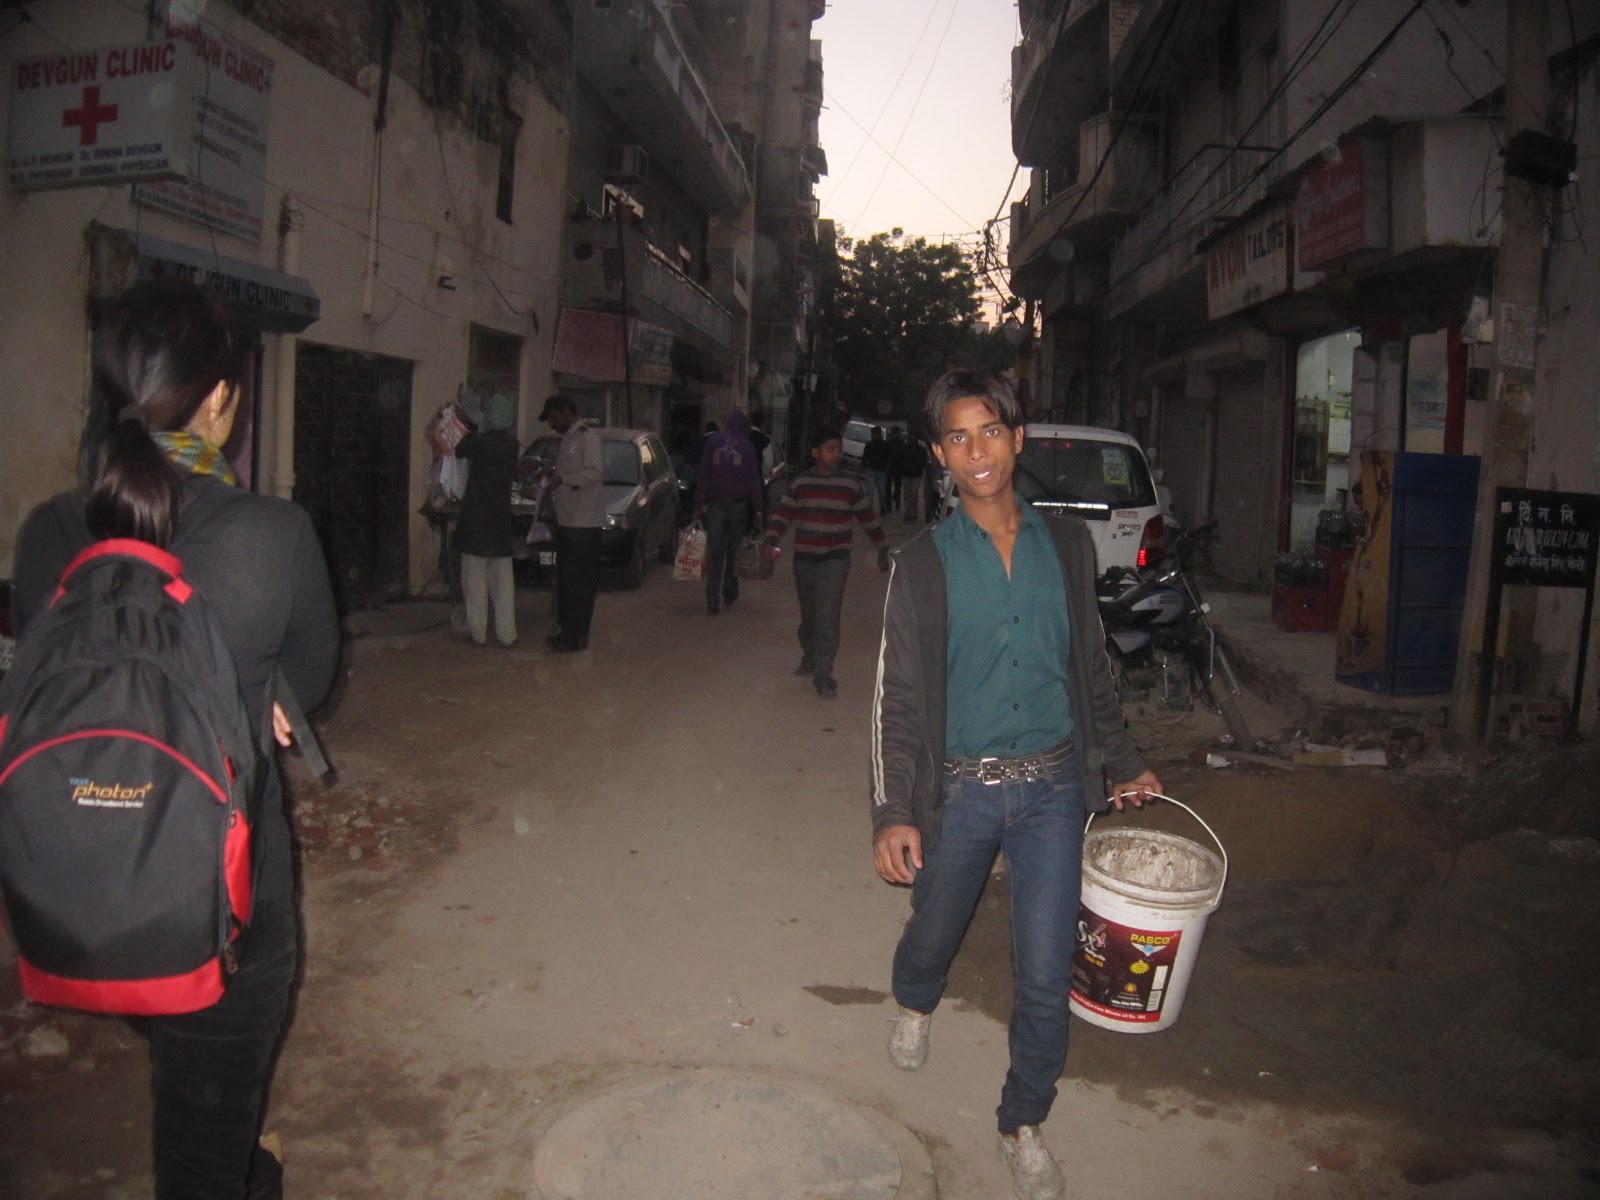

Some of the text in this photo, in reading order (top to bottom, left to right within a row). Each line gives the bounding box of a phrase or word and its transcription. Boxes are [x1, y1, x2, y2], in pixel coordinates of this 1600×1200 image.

[18, 54, 98, 90] DEVGUN
[107, 43, 176, 78] CLINIC
[120, 159, 169, 174] PHYSICIAN
[246, 281, 290, 312] CLINIC
[1130, 933, 1171, 945] PASCO
